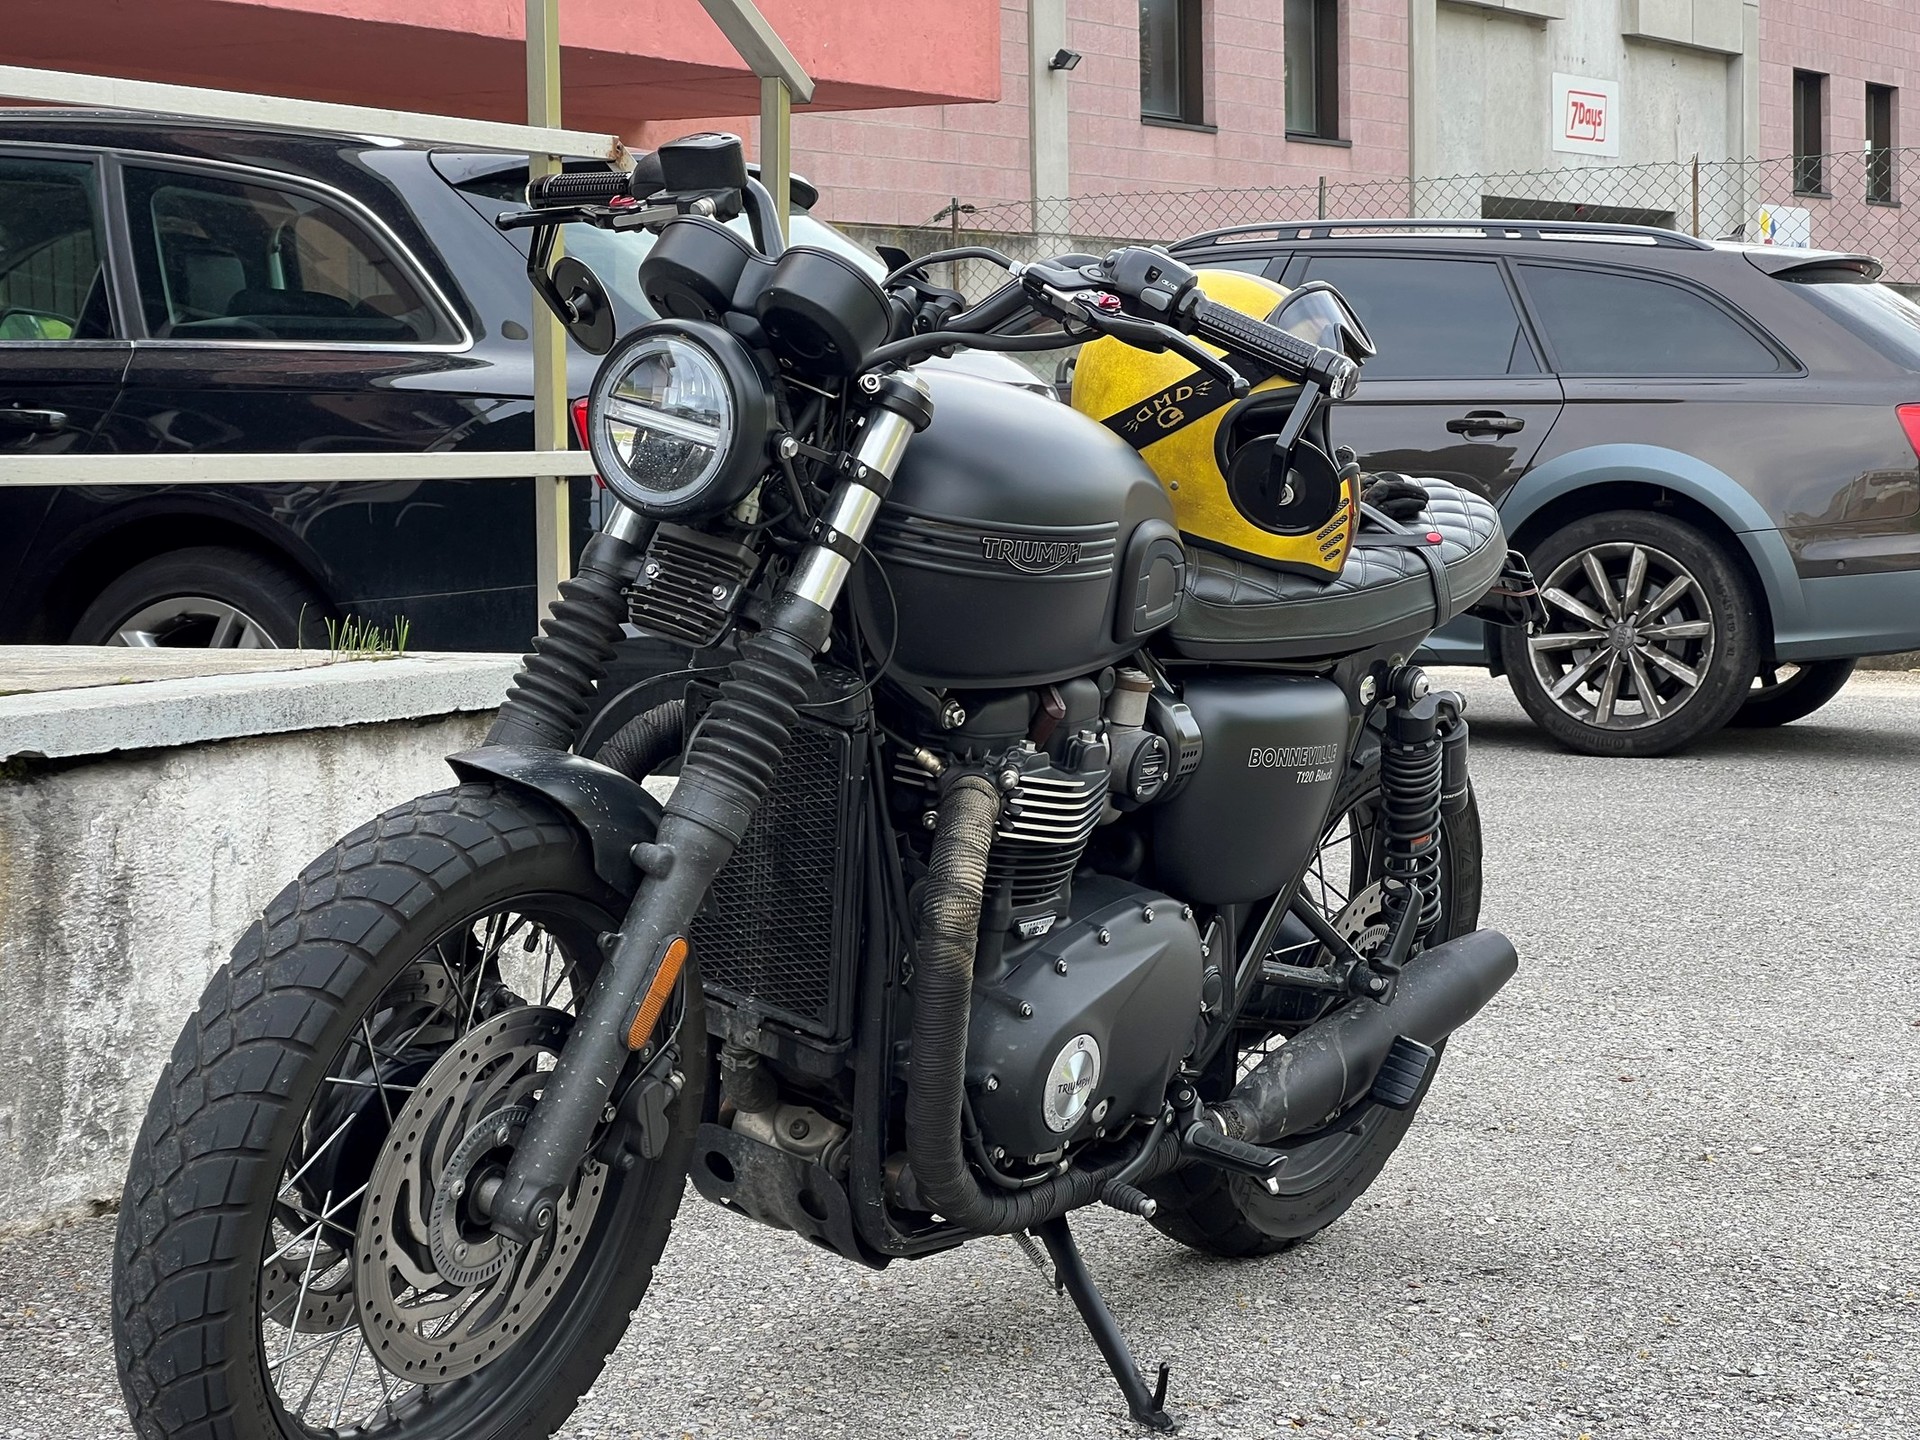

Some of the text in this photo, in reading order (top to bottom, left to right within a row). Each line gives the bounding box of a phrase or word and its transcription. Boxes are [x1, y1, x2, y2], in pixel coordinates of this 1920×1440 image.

[1571, 101, 1603, 134] 7Days
[982, 537, 1082, 574] TRIUMPH
[1248, 743, 1337, 768] BONNEVILLE
[1296, 768, 1332, 783] T120 Black
[1058, 1076, 1090, 1095] TRIUMPH
